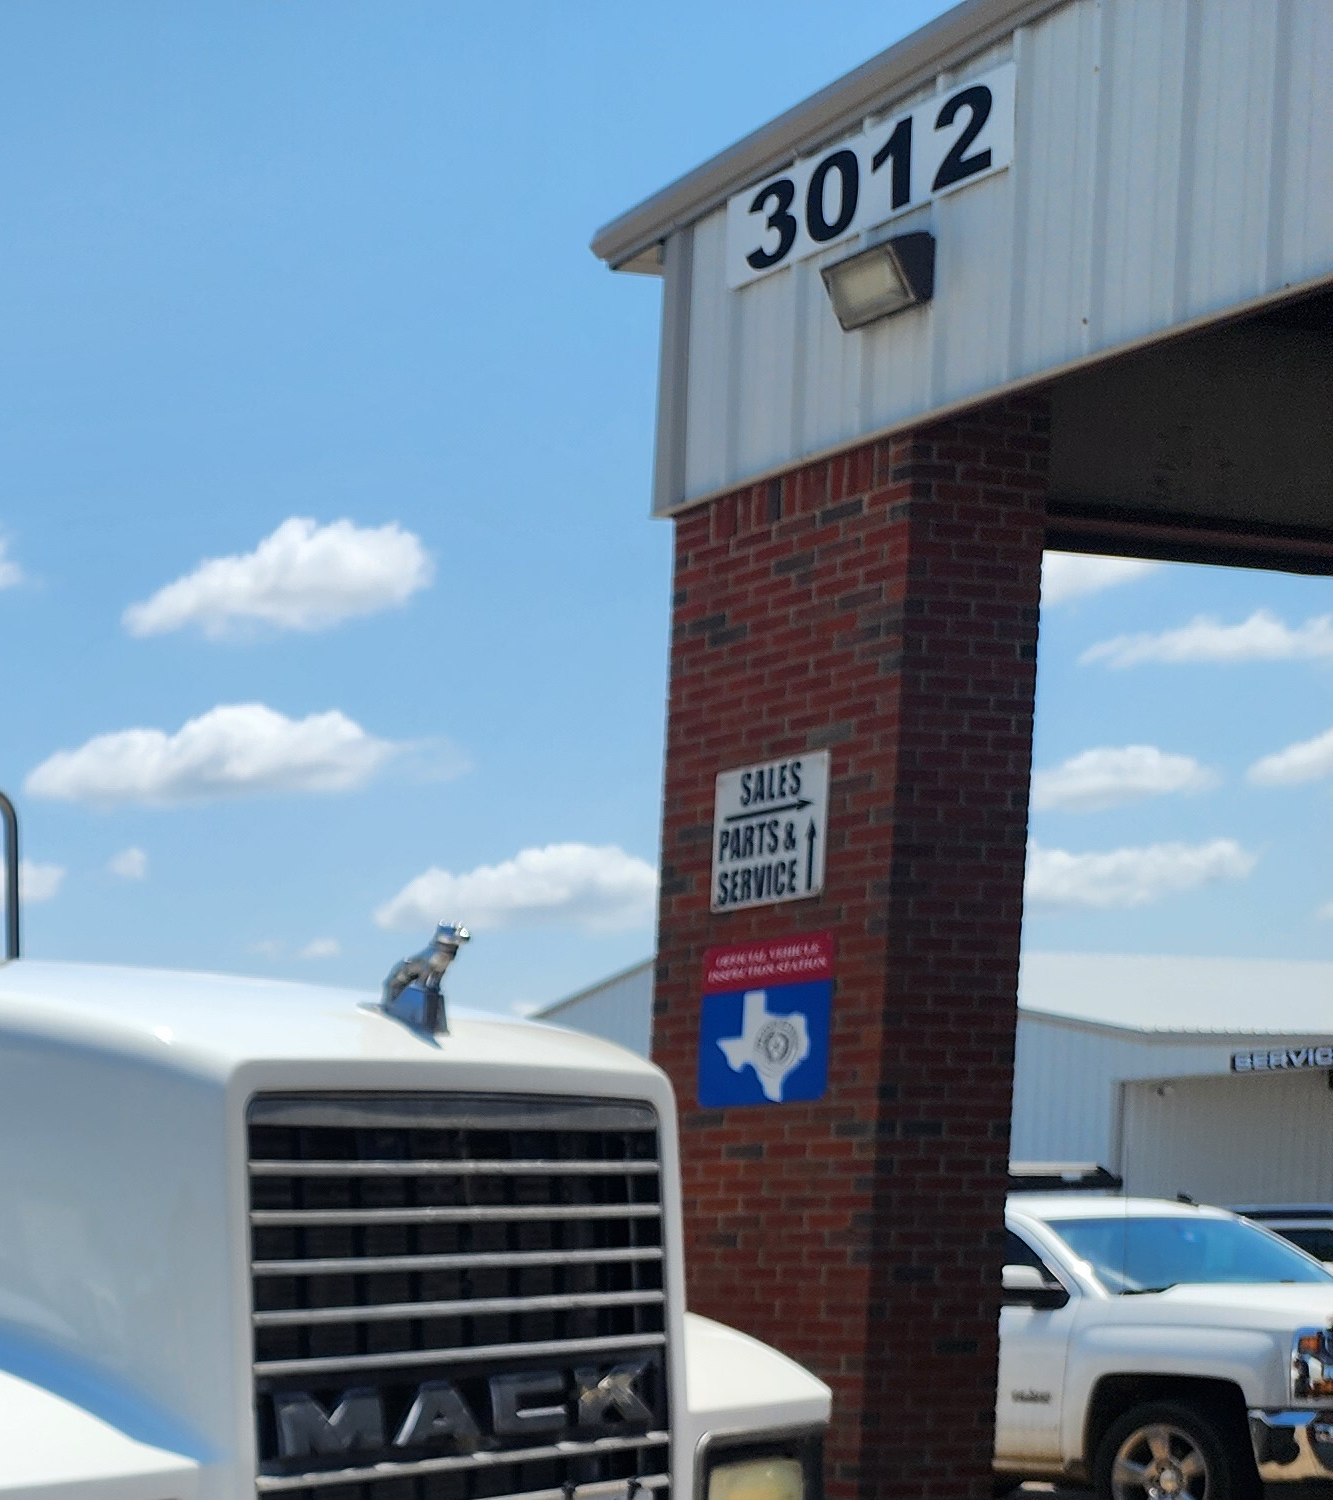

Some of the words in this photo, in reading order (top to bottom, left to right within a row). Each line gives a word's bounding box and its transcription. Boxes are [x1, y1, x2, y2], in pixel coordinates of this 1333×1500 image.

[746, 85, 992, 271] 3012
[741, 762, 801, 806] SALES
[720, 820, 779, 863] PARTS
[784, 823, 796, 850] &
[718, 859, 797, 905] SERVICE
[275, 1362, 653, 1456] MACK
